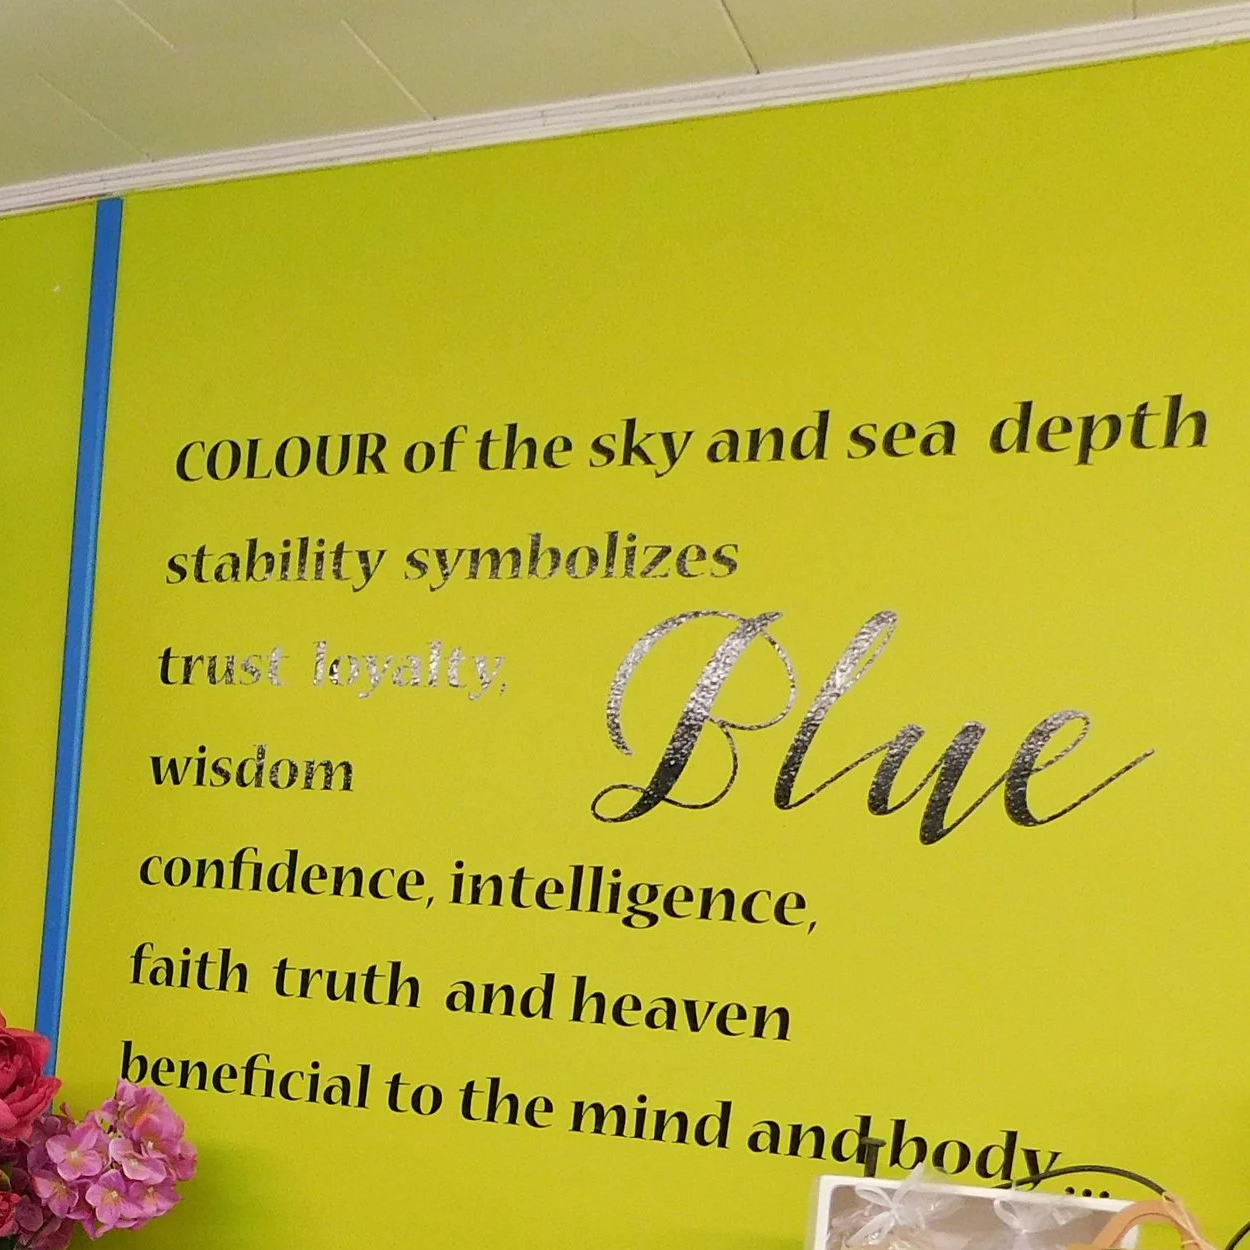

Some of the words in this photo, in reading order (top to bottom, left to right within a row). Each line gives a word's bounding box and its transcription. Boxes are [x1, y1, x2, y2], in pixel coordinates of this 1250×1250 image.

[175, 432, 388, 482] COLOUR
[404, 425, 467, 473] of
[477, 422, 573, 471] the
[589, 416, 694, 478] sky
[707, 409, 831, 463] and
[847, 419, 957, 459] sea
[989, 393, 1208, 466] depth
[166, 536, 387, 593] stability
[404, 530, 739, 592] symbolizes
[158, 646, 290, 687] trust
[313, 639, 507, 701] loyalty,
[150, 744, 354, 792] wisdom
[590, 609, 1155, 846] Blue
[139, 847, 434, 909] confidence,
[451, 859, 817, 935] intelligence,
[130, 942, 248, 994] faith
[273, 957, 421, 1008] truth
[445, 972, 556, 1020] and
[569, 975, 791, 1041] heaven
[120, 1040, 371, 1109] beneficial
[385, 1072, 443, 1117] to
[460, 1077, 554, 1129] the
[570, 1094, 733, 1149] mind
[747, 1114, 872, 1165] and
